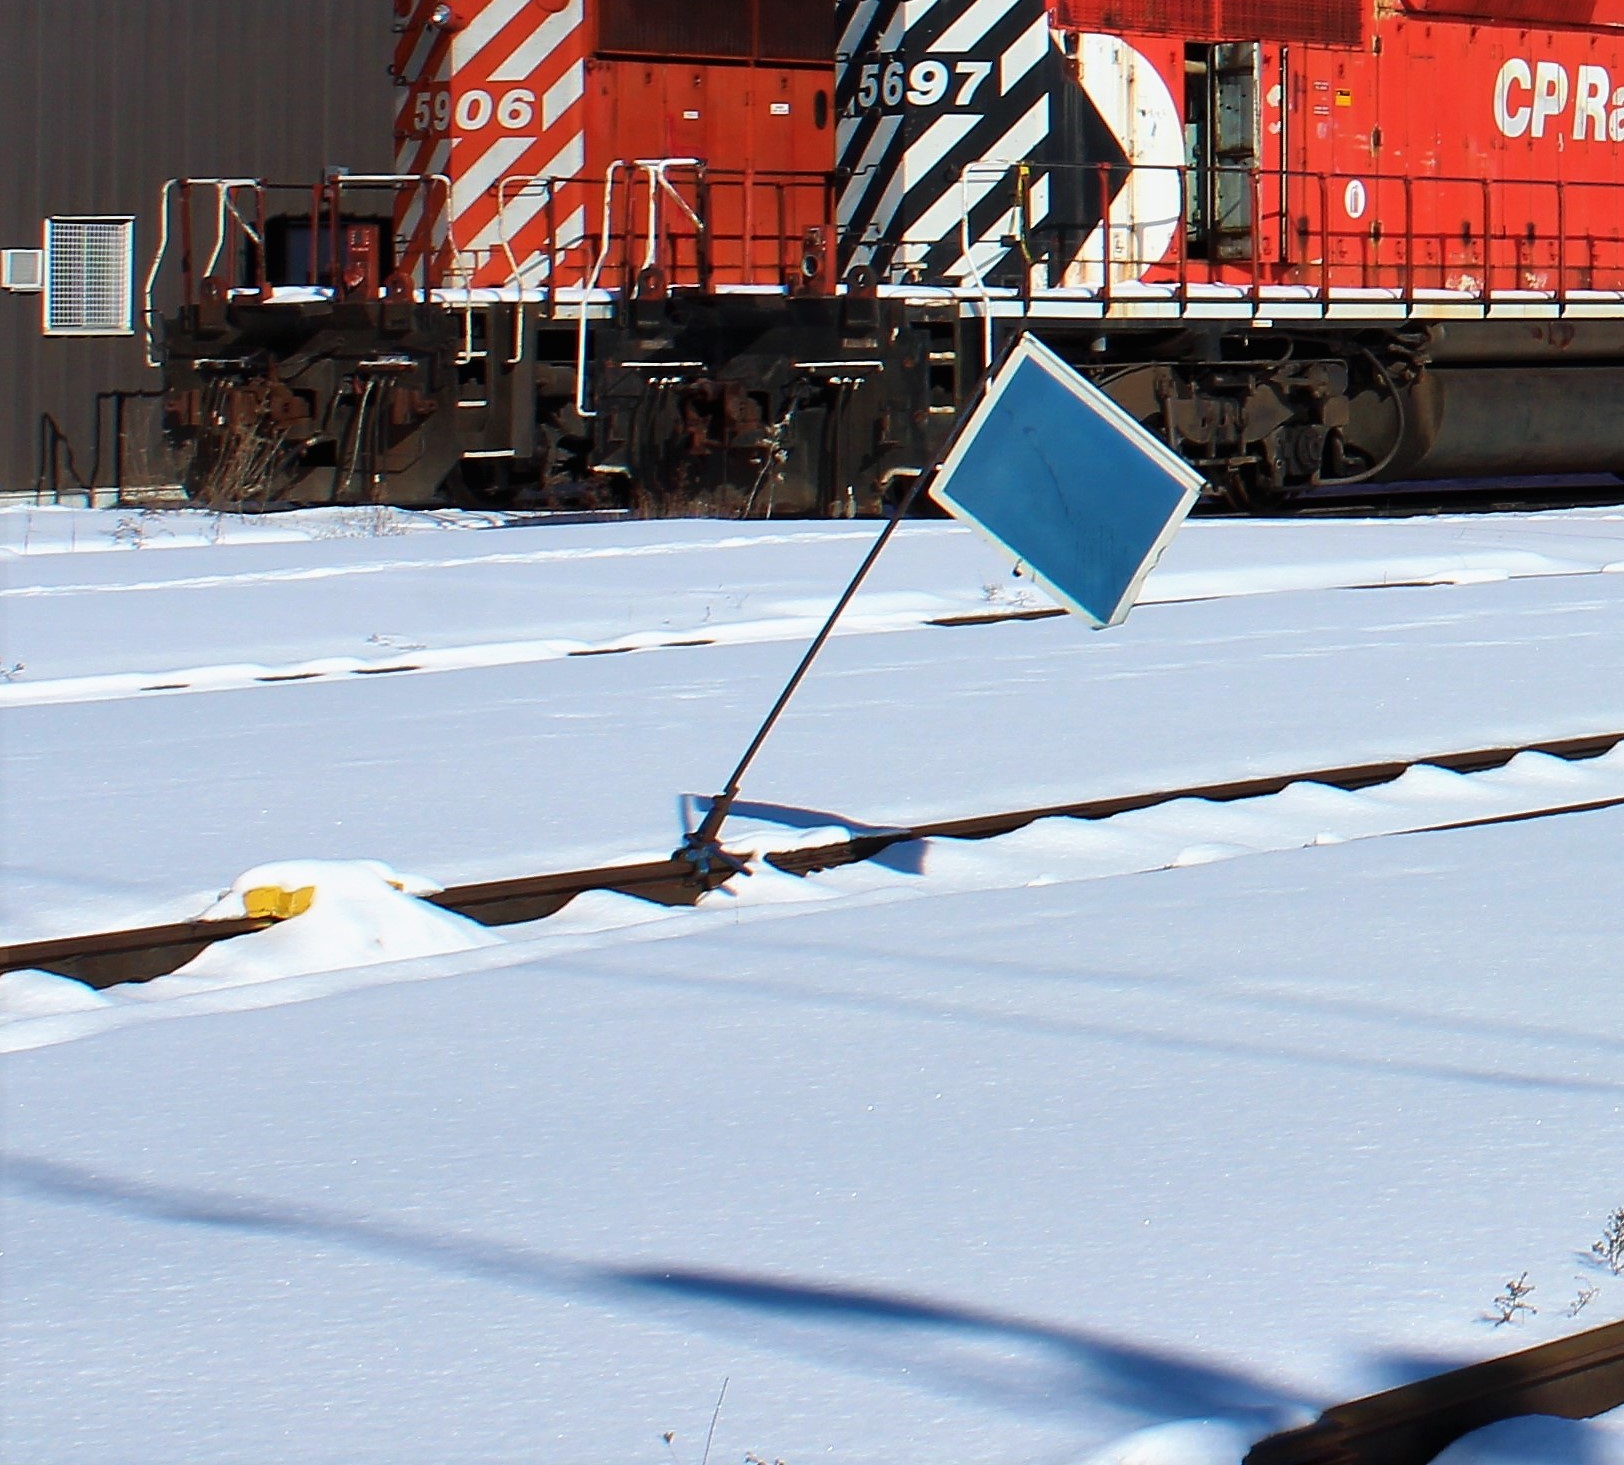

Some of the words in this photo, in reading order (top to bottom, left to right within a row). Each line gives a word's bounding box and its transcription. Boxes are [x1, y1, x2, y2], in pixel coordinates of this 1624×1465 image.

[858, 60, 993, 108] 5697
[1493, 58, 1569, 138] CP
[413, 88, 536, 131] 5906
